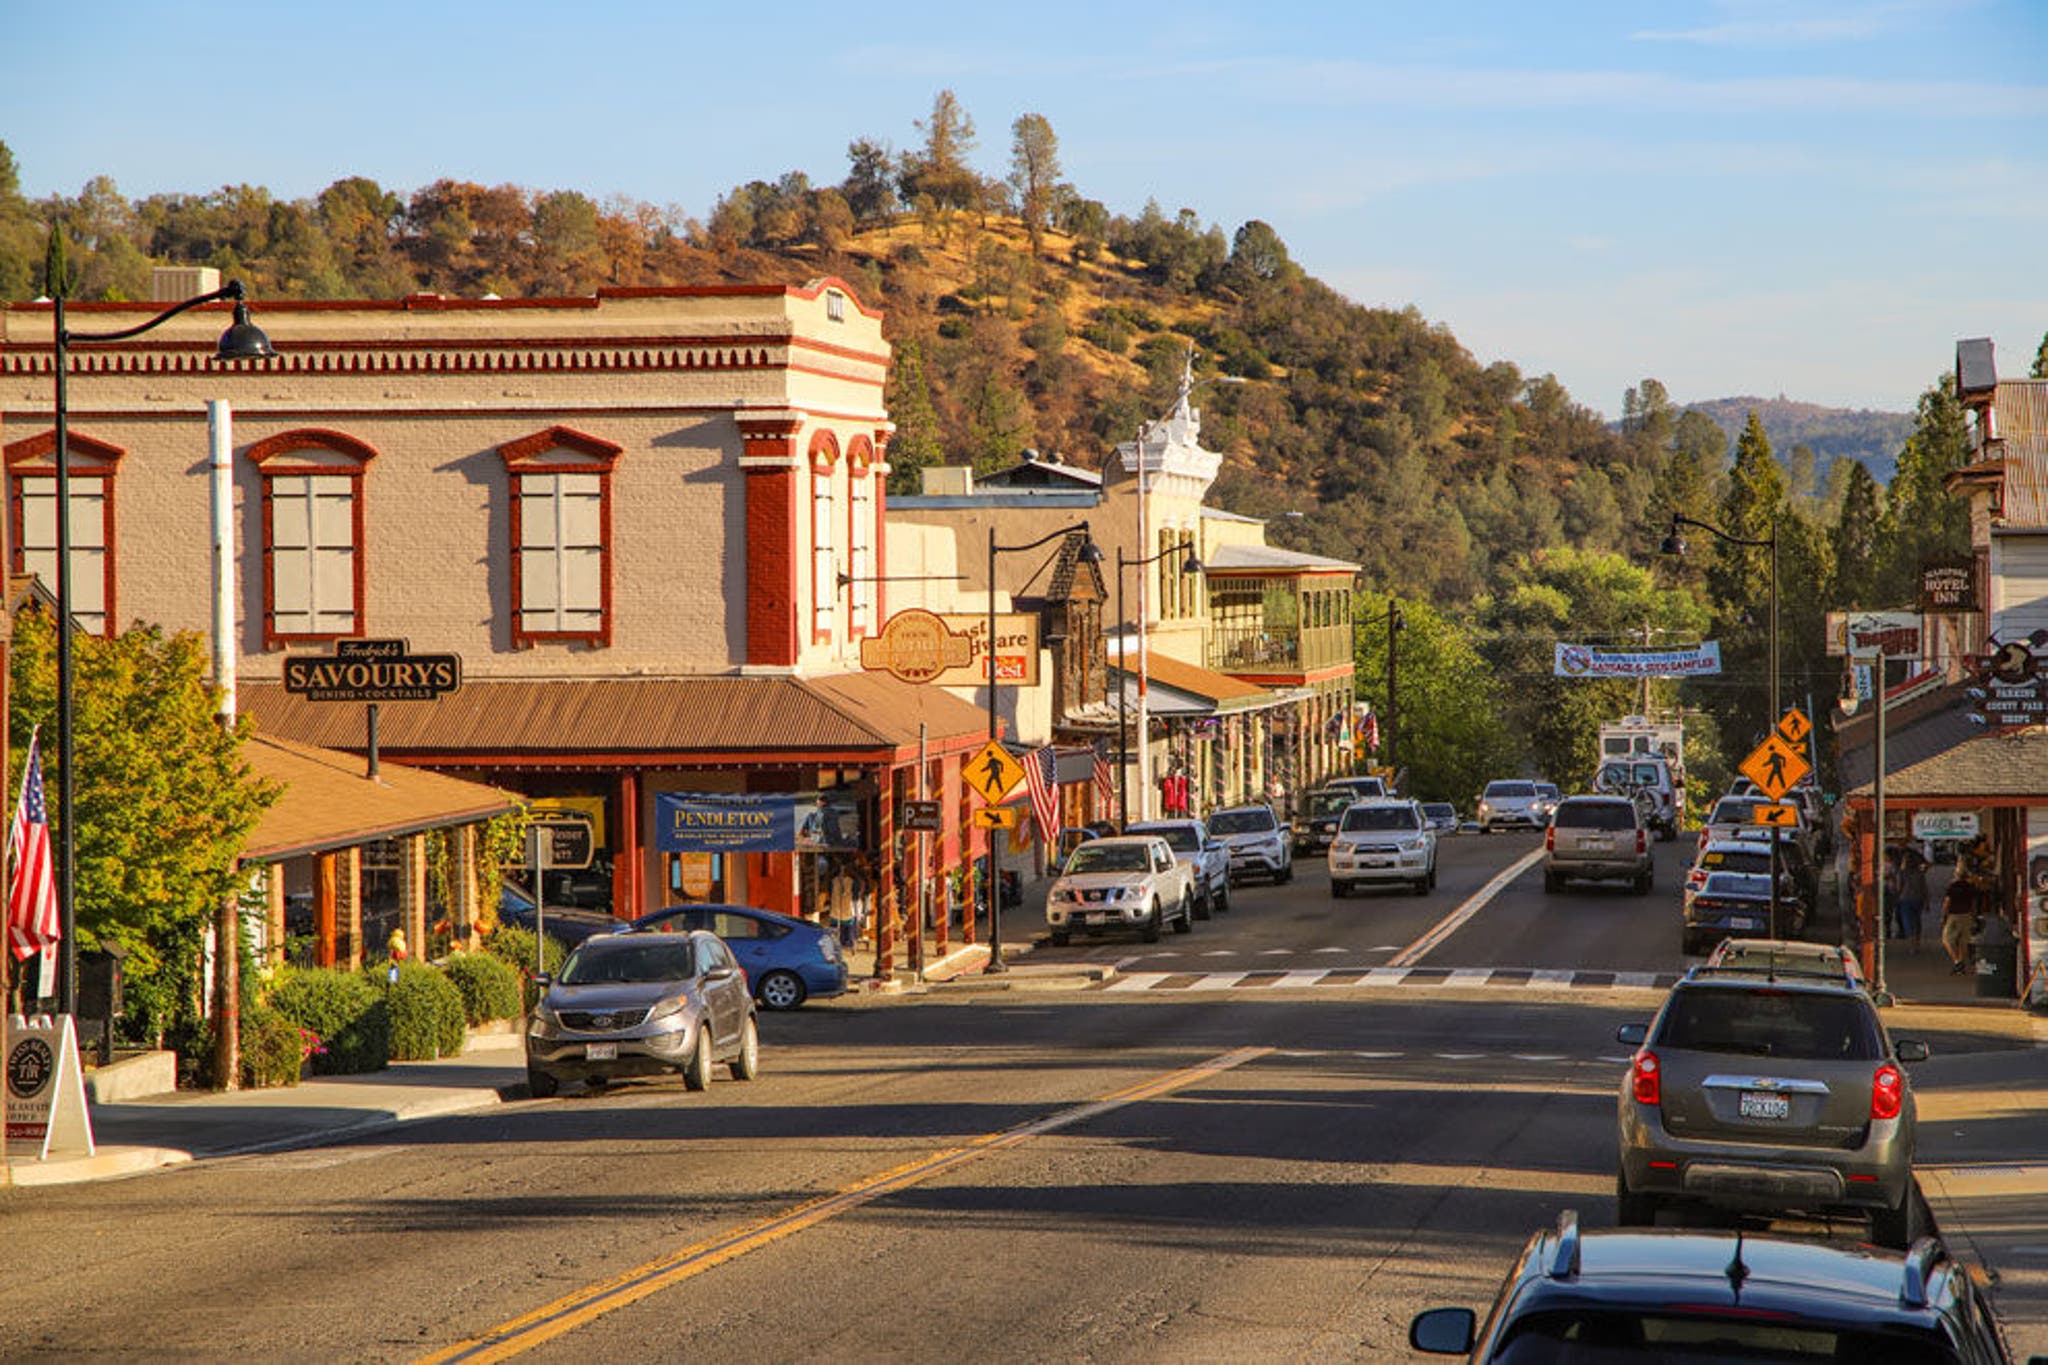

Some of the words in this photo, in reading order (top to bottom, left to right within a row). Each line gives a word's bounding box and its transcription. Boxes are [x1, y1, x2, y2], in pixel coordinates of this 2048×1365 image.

[1924, 578, 1969, 591] HOTEL
[1933, 591, 1960, 604] INN
[289, 663, 453, 689] SAVOURYS
[311, 690, 355, 700] DINING
[364, 690, 432, 700] COCKTAILS
[674, 808, 770, 828] PENDLETON
